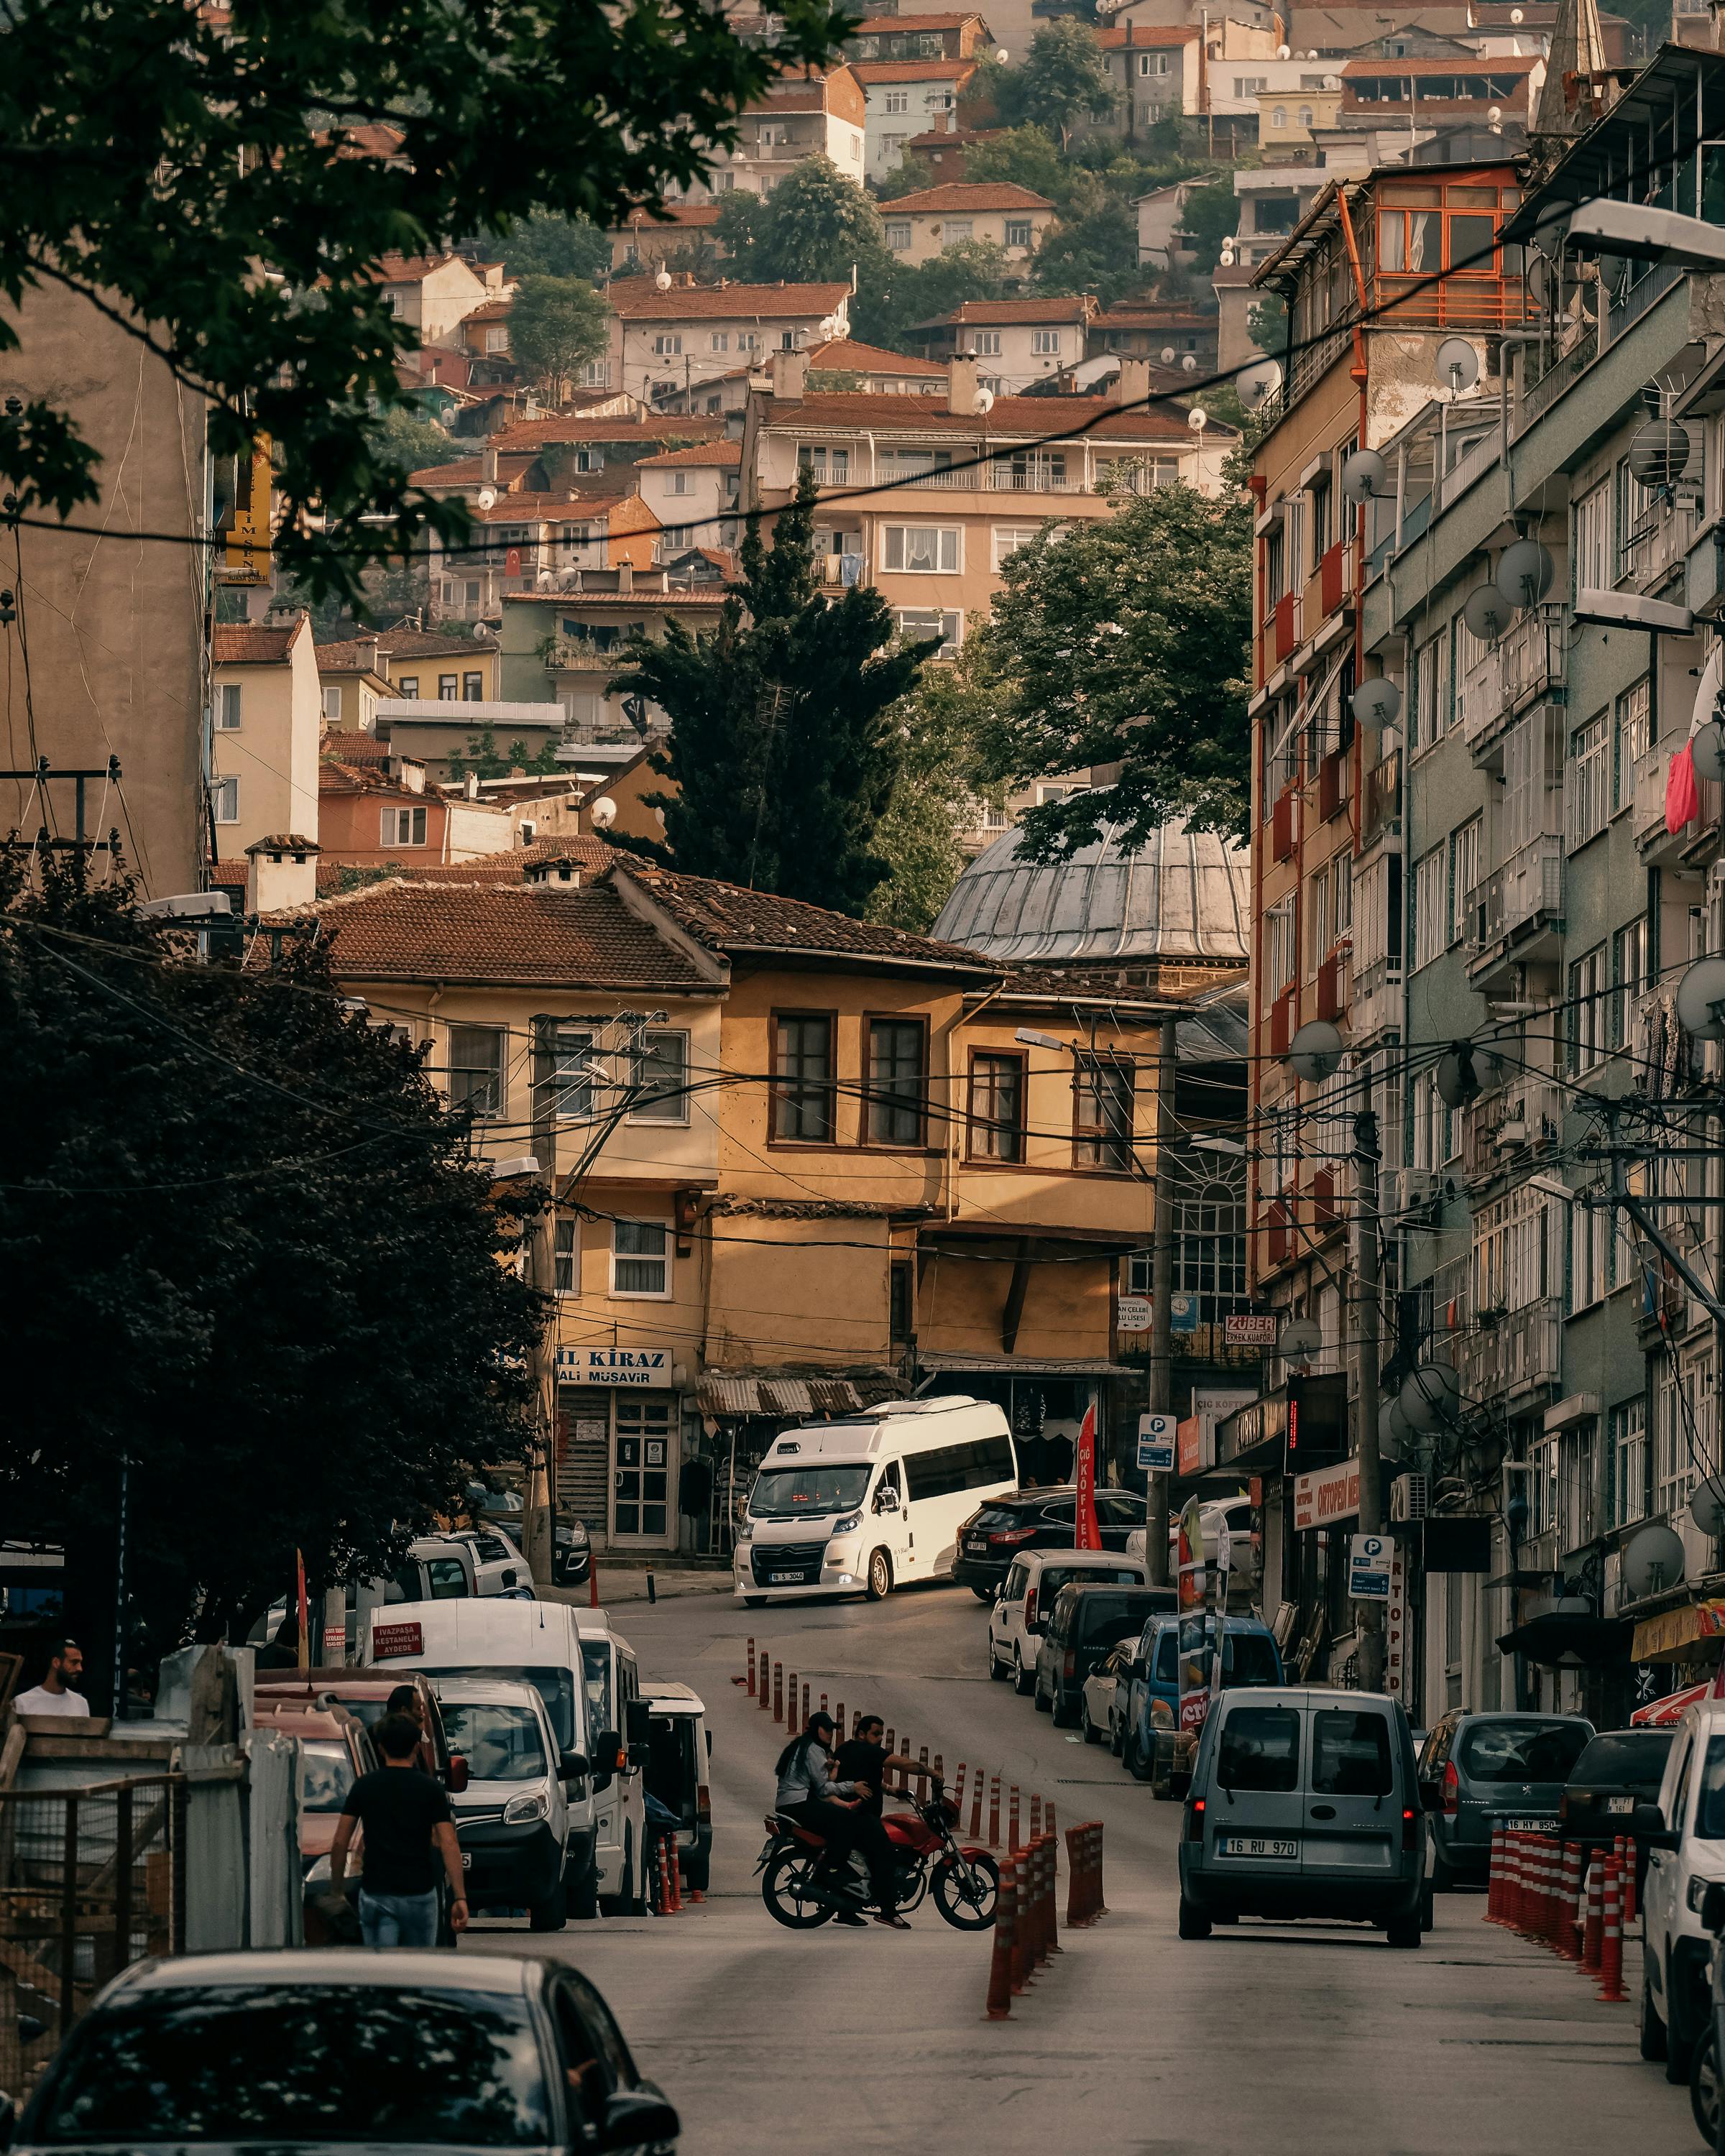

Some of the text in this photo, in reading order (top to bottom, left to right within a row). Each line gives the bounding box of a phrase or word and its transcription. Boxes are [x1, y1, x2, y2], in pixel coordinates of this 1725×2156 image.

[1229, 1317, 1274, 1330] ZÜBER
[1227, 1332, 1245, 1342] ERKEK
[556, 1346, 664, 1368] İL KİRAZ
[559, 1371, 650, 1384] ALİ MÜŞAVİR
[1080, 1446, 1090, 1461] ÇİĞ
[1318, 1470, 1348, 1517] ORTOPEDİ
[380, 1626, 414, 1636] İVAZPAŞA
[375, 1635, 419, 1645] KESTANELİK
[385, 1644, 412, 1653] AYDEDE
[1509, 1820, 1554, 1830] 16 HY 850
[1230, 1840, 1294, 1854] 16 RU 970
